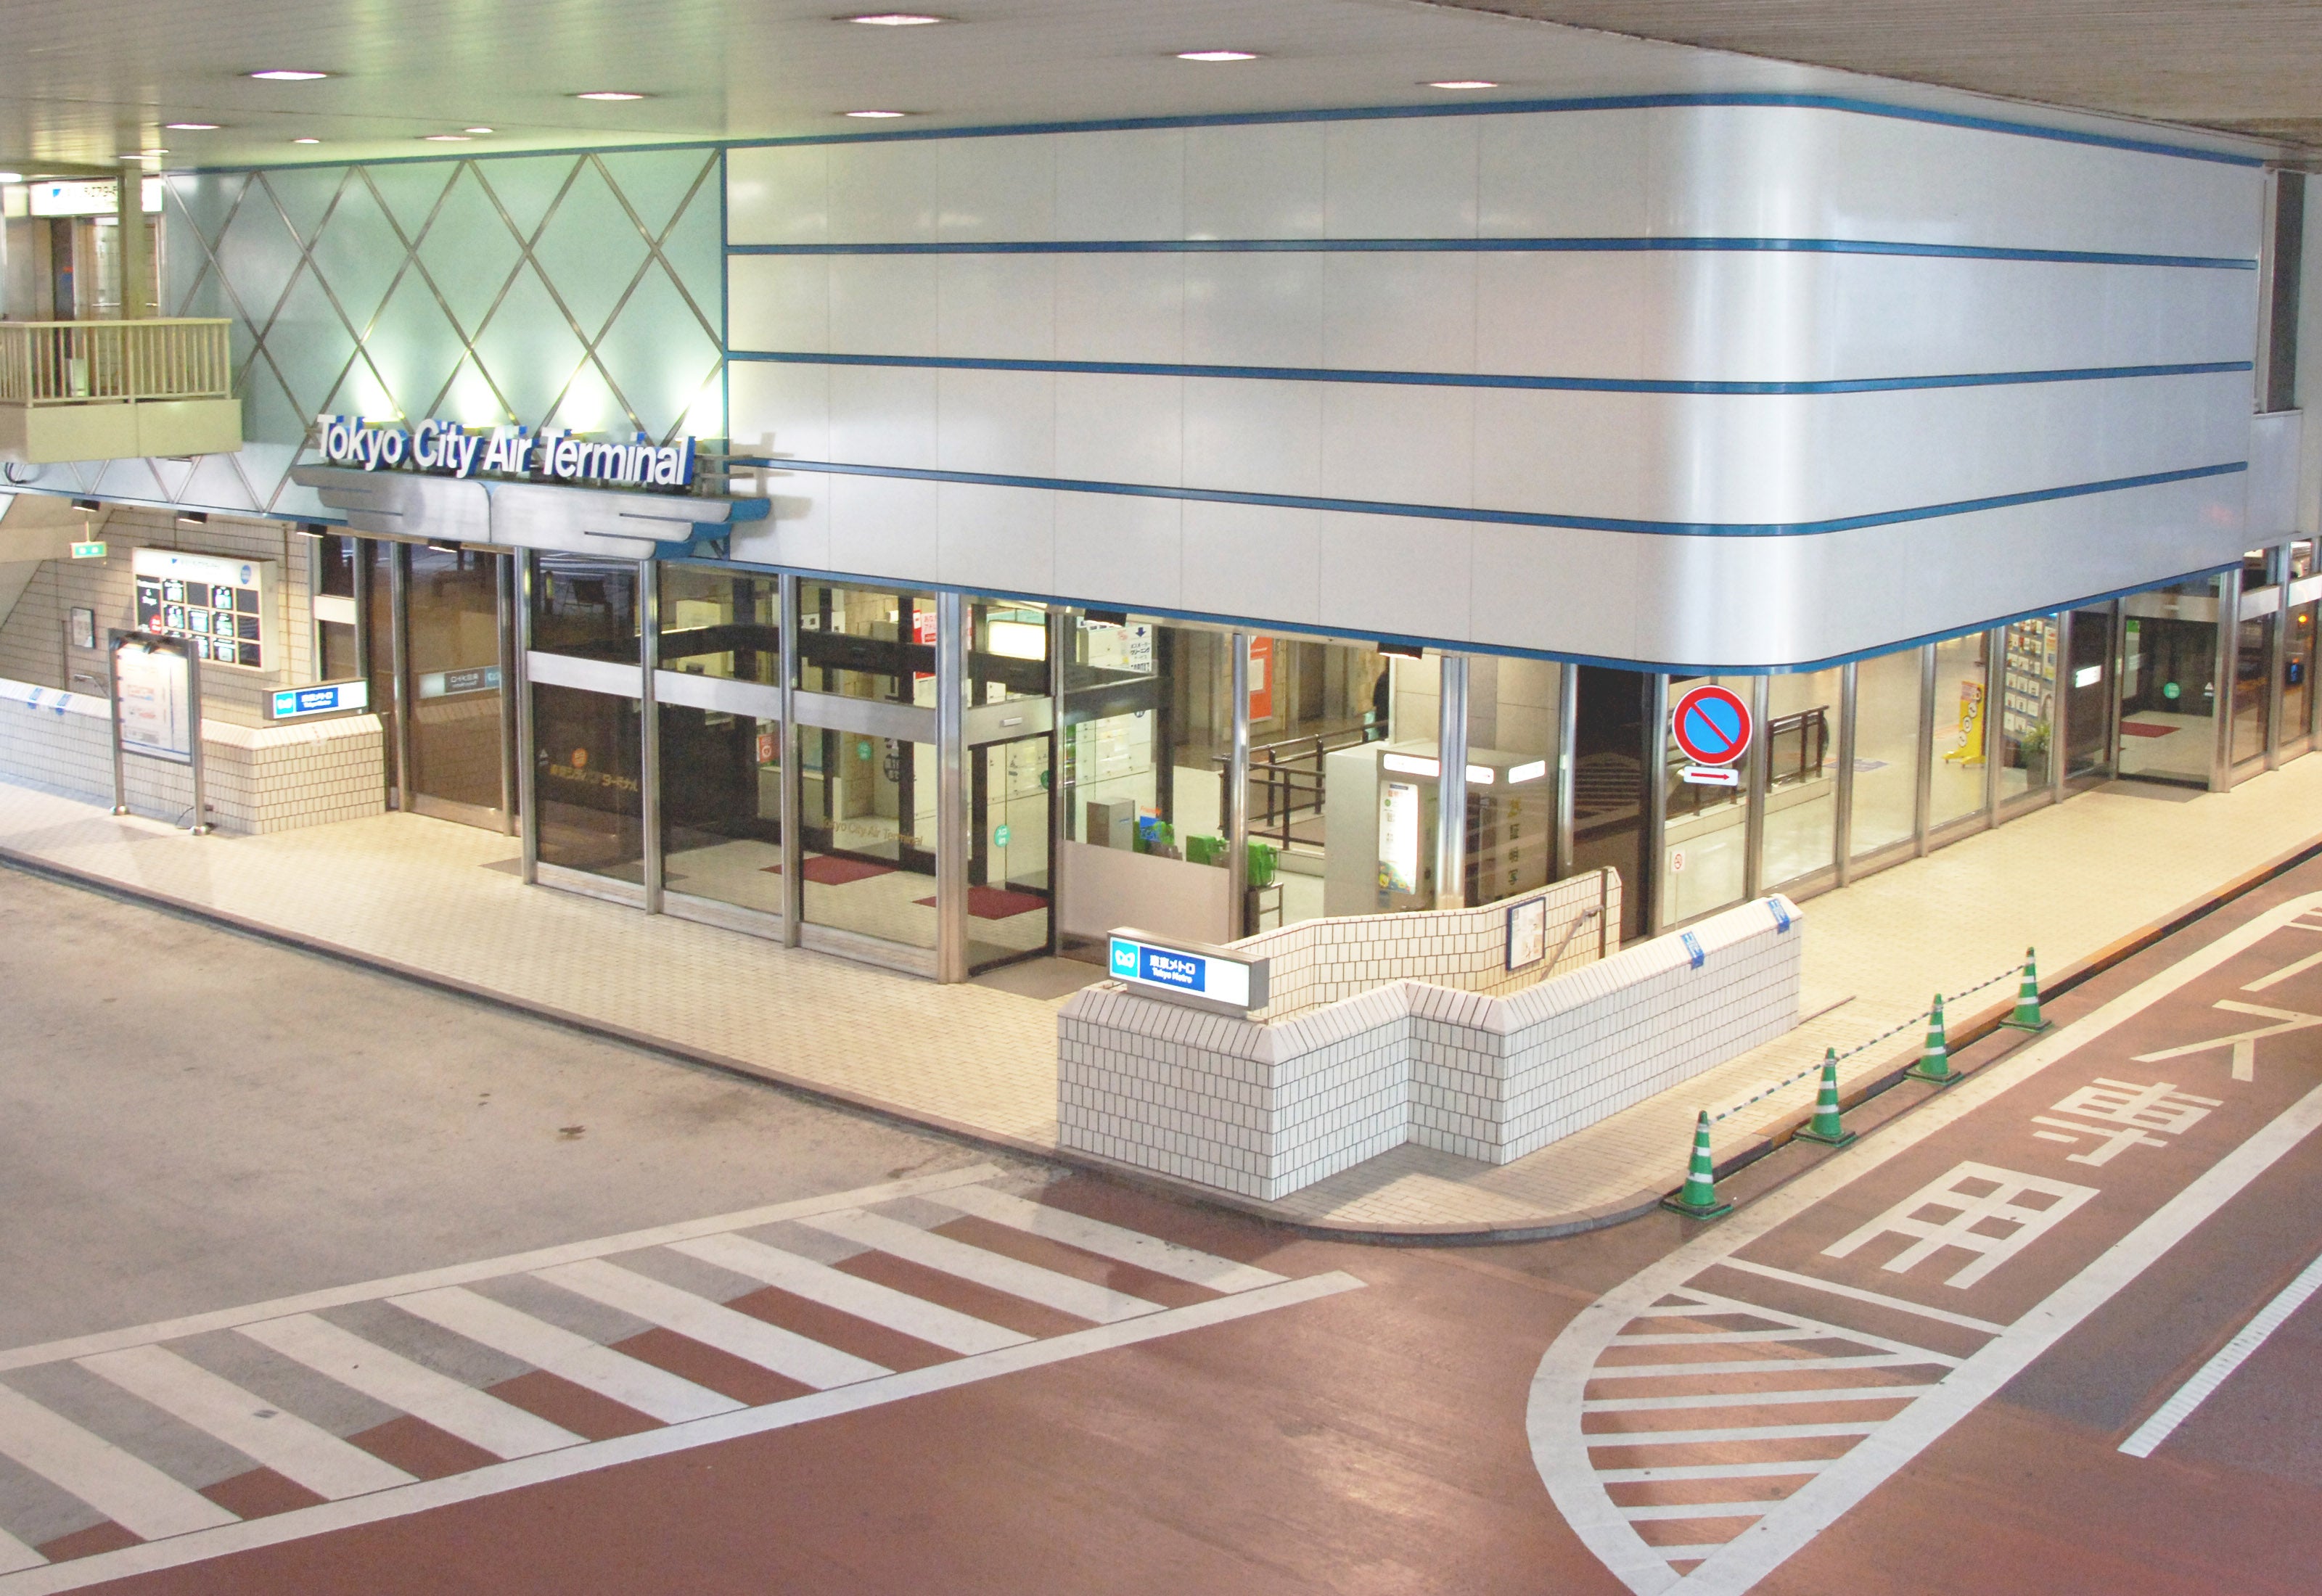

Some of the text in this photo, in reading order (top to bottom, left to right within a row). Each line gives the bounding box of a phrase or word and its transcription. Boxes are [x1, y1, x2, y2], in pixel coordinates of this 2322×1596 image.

[317, 414, 690, 485] Tokyo City Air Terminal
[1149, 954, 1197, 975] 東京メトロ
[1152, 967, 1193, 984] Tokyo Metro
